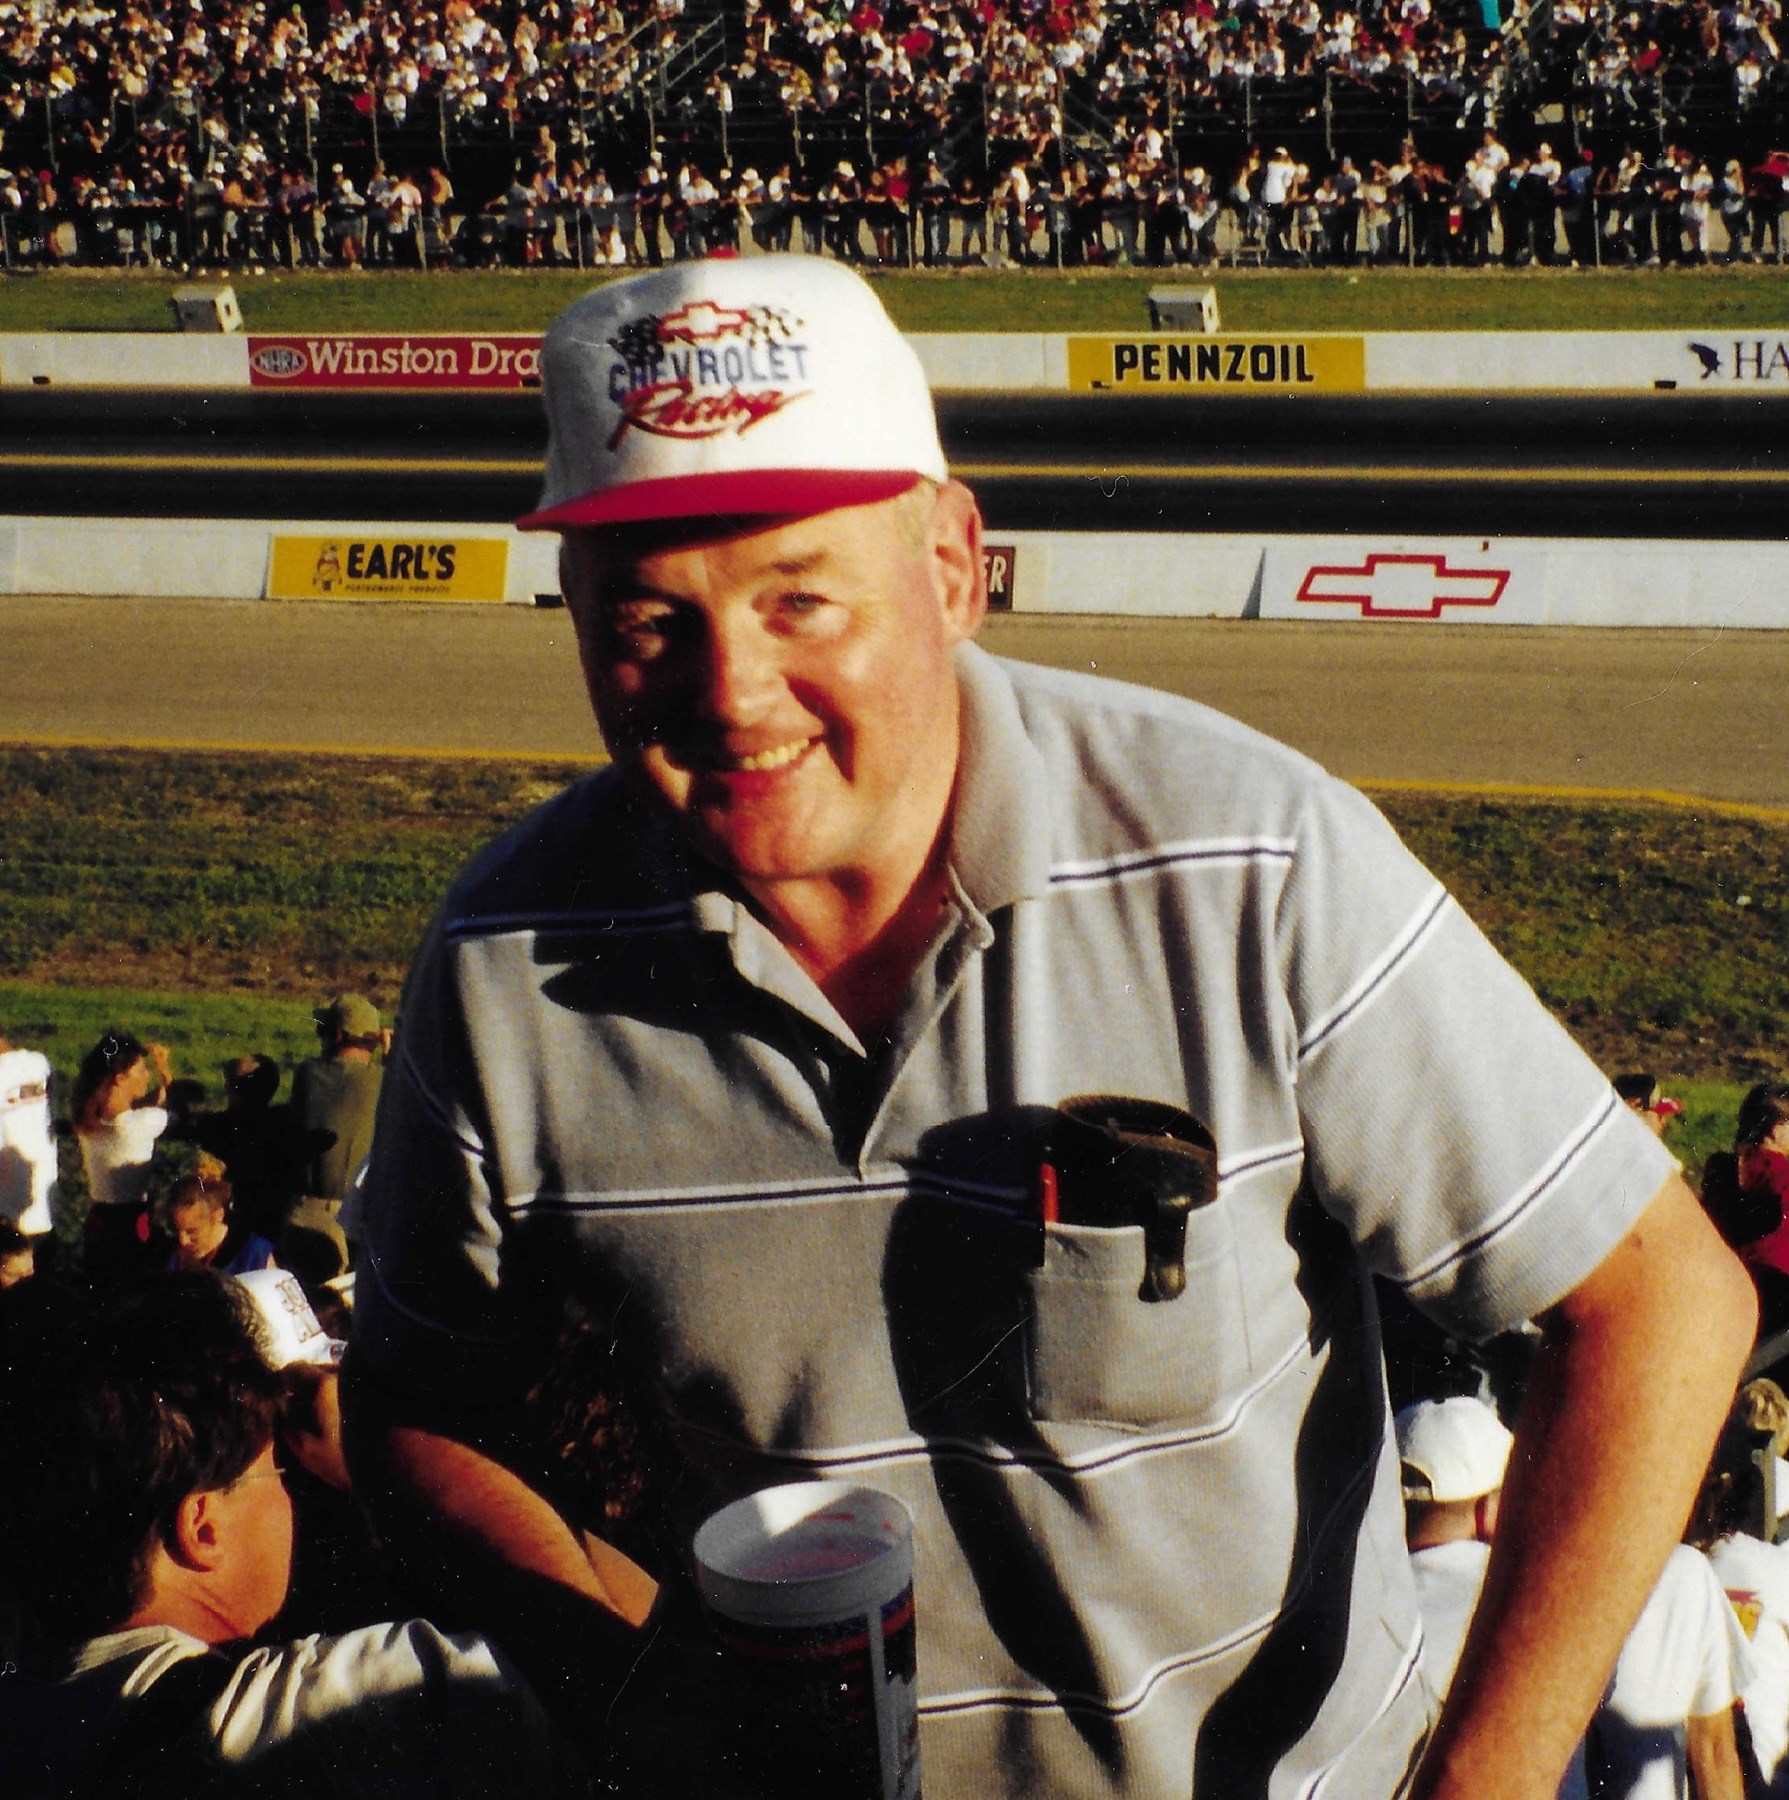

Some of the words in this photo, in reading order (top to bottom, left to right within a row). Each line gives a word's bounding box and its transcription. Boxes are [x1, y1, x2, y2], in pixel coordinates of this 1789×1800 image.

[307, 341, 459, 375] Winston
[608, 344, 808, 404] CHEVROLET
[1114, 344, 1314, 382] PENNZOIL
[1733, 341, 1789, 379] HA
[346, 543, 456, 580] EARL'S
